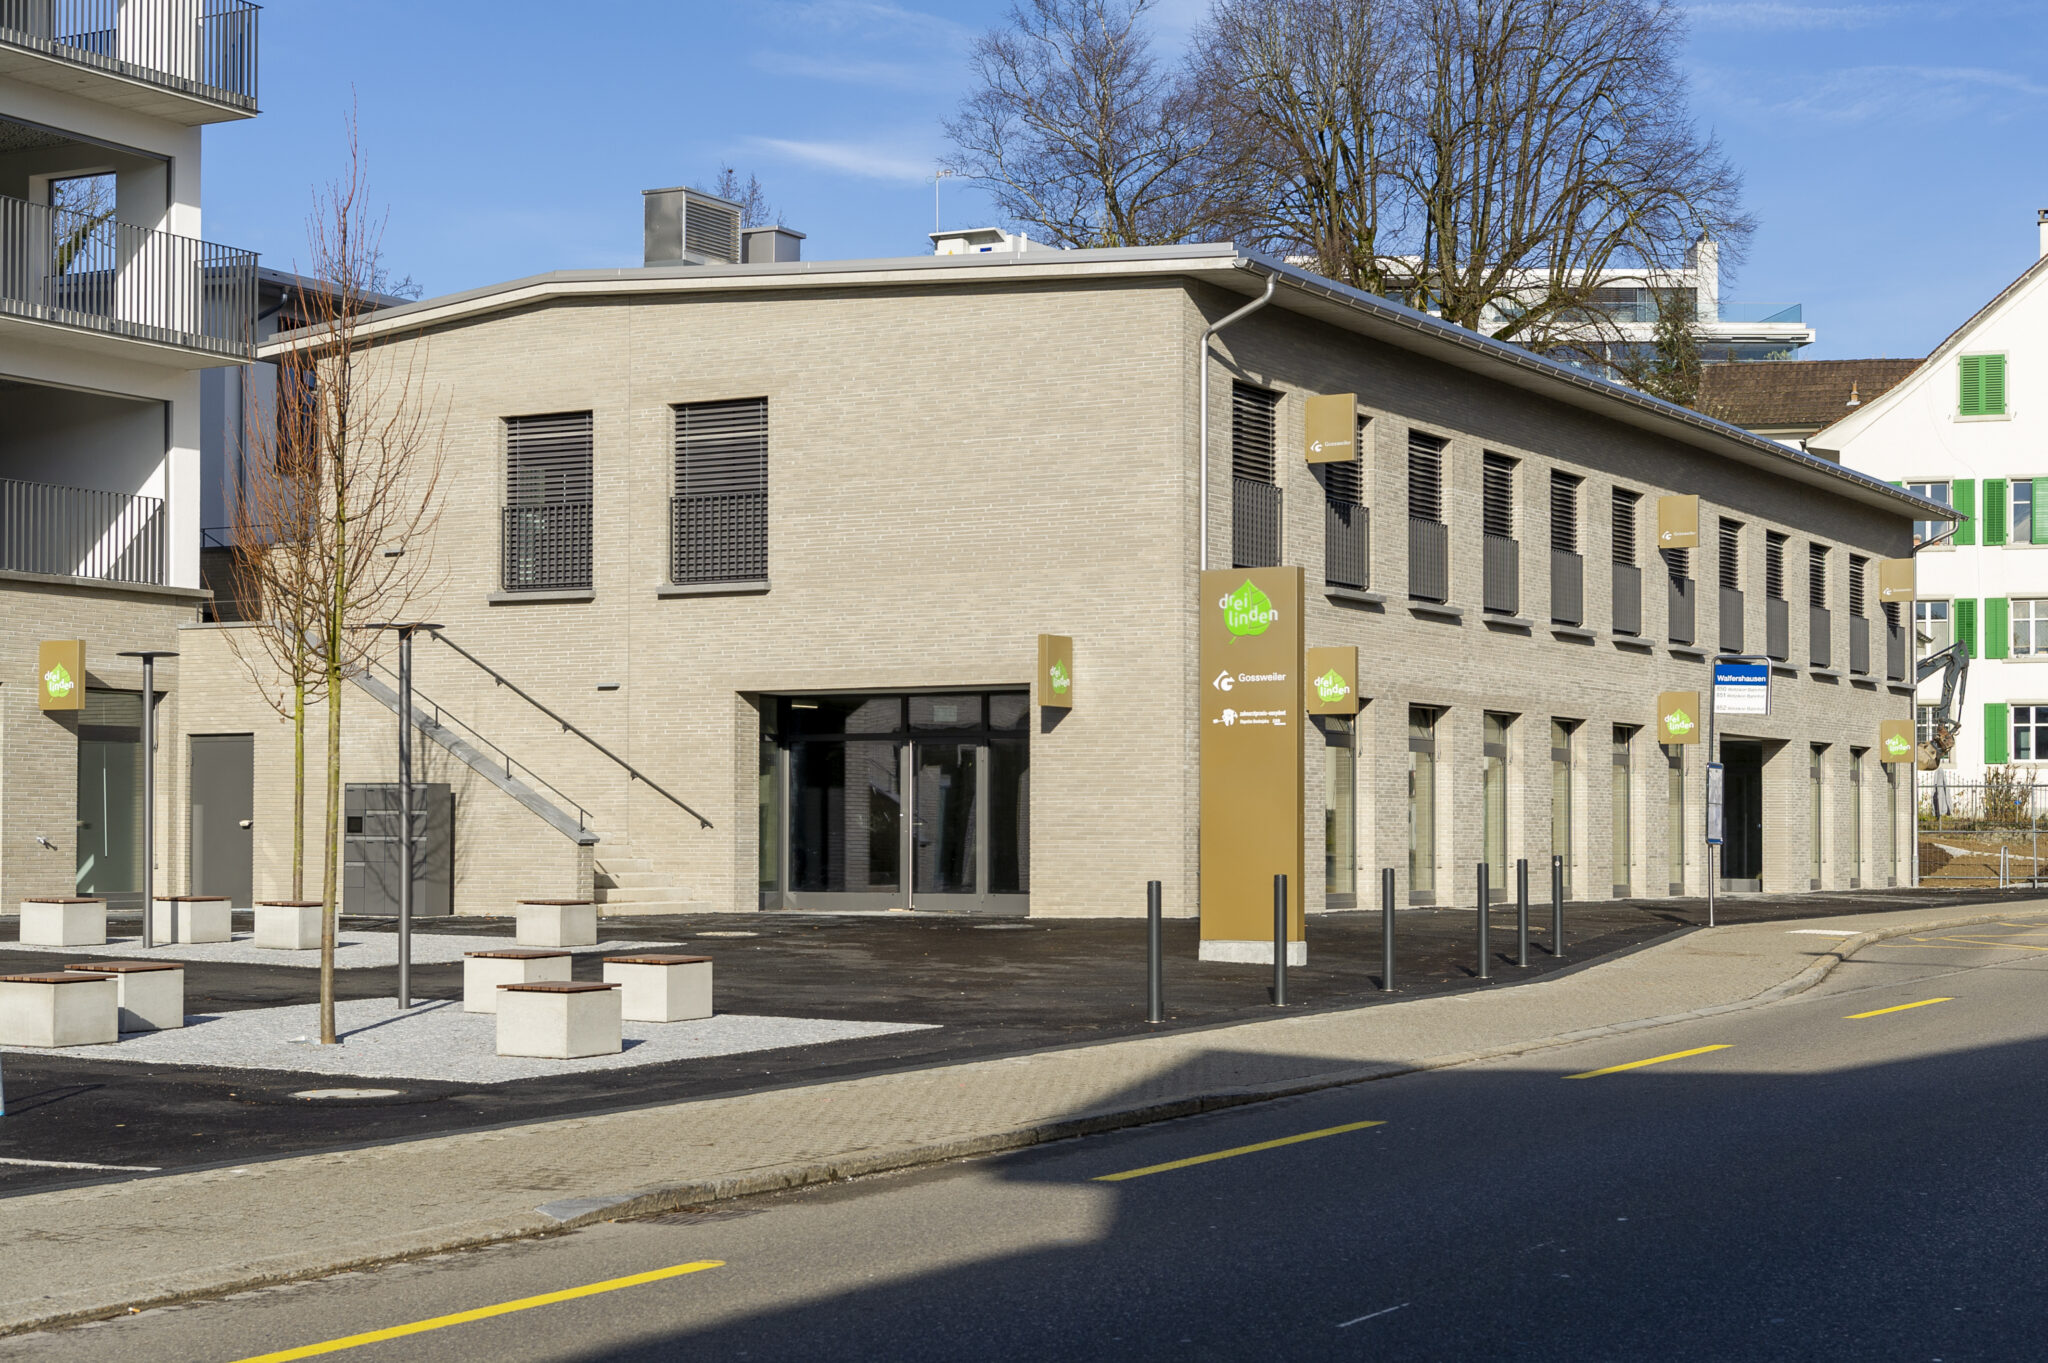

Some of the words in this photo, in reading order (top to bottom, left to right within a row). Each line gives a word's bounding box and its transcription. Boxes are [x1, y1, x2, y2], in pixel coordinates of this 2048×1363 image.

[1218, 593, 1248, 611] drei
[1228, 605, 1279, 628] linden
[44, 670, 60, 682] drei
[1238, 672, 1287, 682] Gossweiler
[1313, 676, 1333, 688] drei
[1716, 674, 1767, 683] Walfershausen
[49, 678, 74, 692] linden
[1320, 683, 1350, 697] linden
[1664, 713, 1680, 724] drei
